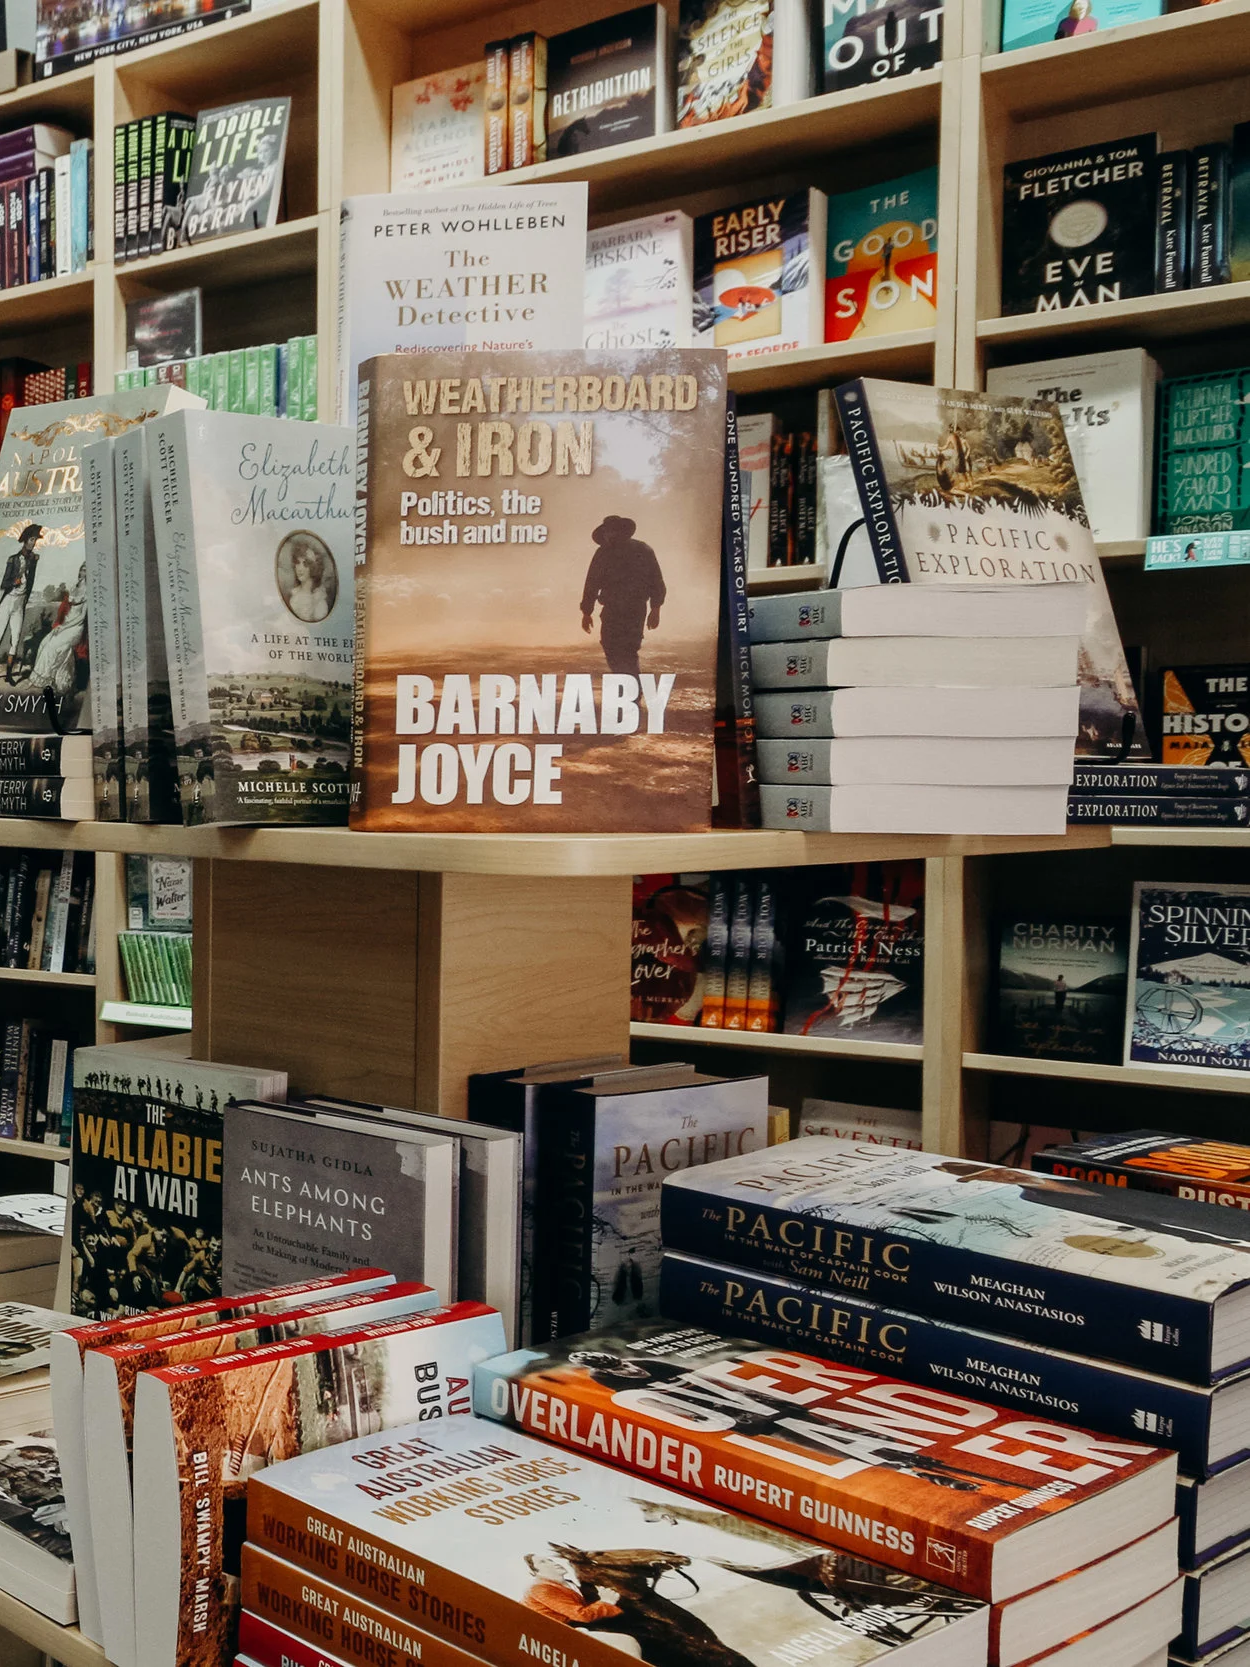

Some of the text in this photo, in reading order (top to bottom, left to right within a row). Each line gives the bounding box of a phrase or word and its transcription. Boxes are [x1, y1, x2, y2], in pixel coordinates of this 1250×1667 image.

[74, 19, 204, 62] NEW YORK CITY, NEW YORK, USA
[697, 11, 761, 52] SILENCE
[829, 11, 944, 72] OUT
[708, 47, 752, 78] GIRLS
[871, 54, 906, 77] OF
[553, 67, 651, 118] RETRIBUTION
[197, 105, 286, 145] A DOUBLE
[200, 127, 265, 174] LIFE
[1023, 147, 1139, 180] GIOVANNA & TOM
[204, 173, 270, 208] FLYNN
[1019, 161, 1144, 200] FLETCHER
[188, 200, 252, 237] BERRY
[383, 208, 422, 217] Bestselling
[424, 206, 449, 214] author
[461, 203, 475, 212] The
[477, 202, 506, 212] Hidden
[509, 201, 524, 210] Life
[536, 200, 558, 208] Trees
[712, 201, 786, 238] EARLY
[870, 190, 910, 214] THE
[374, 215, 566, 237] PETER WOHLLEBEN
[591, 230, 654, 251] BARBARA
[715, 222, 781, 259] RISER
[833, 218, 938, 263] GOOD
[1161, 164, 1176, 289] BETRAYAL Kate Furnivall
[444, 250, 490, 268] The
[1045, 252, 1115, 284] EVE
[385, 272, 549, 301] WEATHER
[835, 269, 934, 318] SON
[1036, 282, 1121, 313] MAN
[397, 303, 536, 327] Detective
[482, 339, 534, 351] Nature's
[403, 375, 698, 416] WEATHERBOARD
[726, 410, 736, 445] ONE
[847, 406, 875, 474] PACIFIC
[402, 421, 593, 478] & IRON
[239, 439, 352, 501] Elizabeth
[728, 449, 740, 522] HUNDRED
[231, 482, 356, 526] Macarthur
[400, 489, 541, 517] Politics, the
[1170, 512, 1234, 525] JONAS
[400, 519, 548, 545] bush and me
[947, 523, 1050, 552] PACIFIC
[1151, 539, 1182, 553] HE'S
[918, 552, 1097, 584] EXPLORATION
[734, 576, 745, 602] OF
[736, 603, 748, 633] DIRT
[251, 634, 259, 643] A
[264, 634, 290, 645] LIFE
[295, 636, 310, 646] AT
[314, 637, 338, 648] THE
[269, 650, 313, 661] OF THE
[396, 673, 676, 735] BARNABY
[1162, 712, 1250, 734] HISTO
[237, 781, 351, 794] MICHELLE SCOTT
[391, 743, 563, 806] JOYCE
[1076, 774, 1158, 787] EXPLORATION
[805, 939, 921, 957] Patrick Ness
[1012, 936, 1115, 953] NORMAN
[1013, 922, 1115, 939] CHARITY
[1158, 1051, 1207, 1065] NAOMI
[145, 1102, 166, 1127] THE
[78, 1113, 223, 1183] WALLABIE
[251, 1140, 374, 1177] SUJATHA GIDLA
[113, 1165, 199, 1219] AT WAR
[240, 1167, 385, 1216] ANTS AMONG
[251, 1195, 373, 1242] ELEPHANTS
[701, 1206, 911, 1273] The PACIFIC
[764, 1241, 908, 1283] WAKE OF CAPTAIN COOK
[789, 1260, 870, 1291] Sam Neill
[933, 1281, 1086, 1326] WILSON ANASTASIOS
[970, 1274, 1046, 1301] MEAGHAN
[490, 1378, 704, 1490] OVERLANDER
[192, 1451, 209, 1489] BILL
[351, 1437, 444, 1470] GREAT
[354, 1444, 521, 1501] AUSTRALIAN
[371, 1456, 583, 1526] WORKING HORSE
[463, 1484, 582, 1526] STORIES
[713, 1464, 916, 1556] RUPERT GUINNESS
[193, 1578, 209, 1633] MARSH
